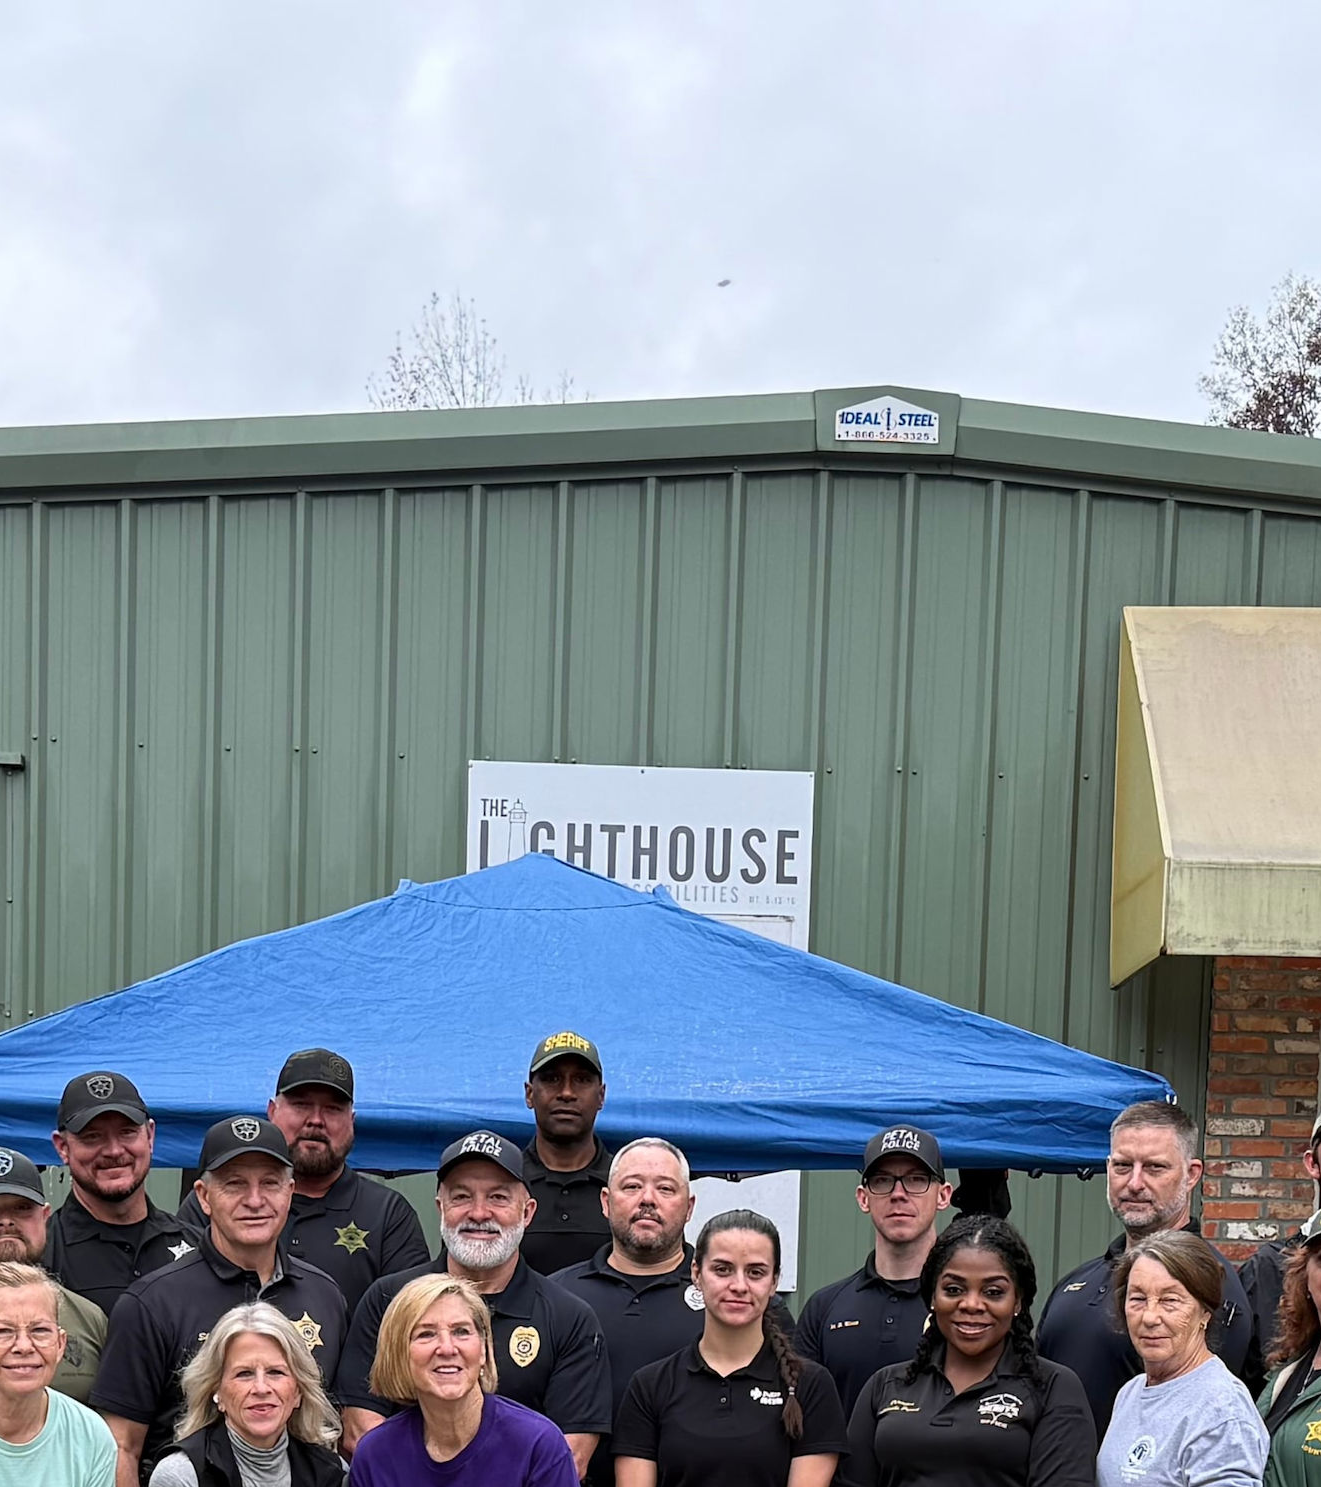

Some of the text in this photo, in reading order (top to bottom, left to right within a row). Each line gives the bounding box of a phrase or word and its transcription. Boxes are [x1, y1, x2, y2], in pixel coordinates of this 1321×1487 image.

[840, 411, 934, 427] IDEAL STEEL
[481, 798, 508, 817] THE
[544, 1031, 590, 1052] SHERIFF
[462, 1133, 502, 1149] PETAL
[882, 1129, 919, 1143] PETAL
[459, 1142, 502, 1157] POLICE
[881, 1139, 921, 1152] POLICE
